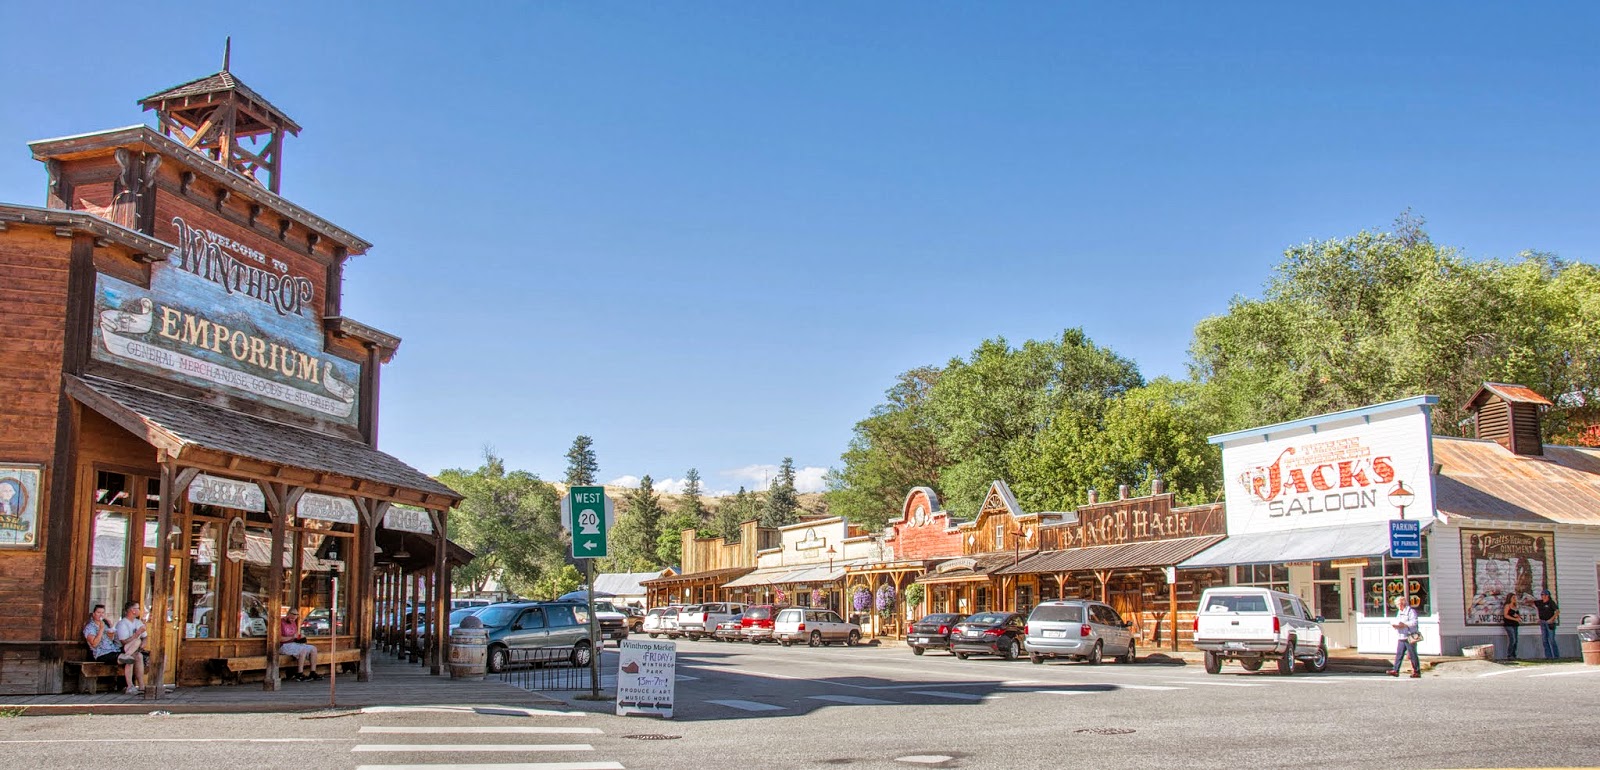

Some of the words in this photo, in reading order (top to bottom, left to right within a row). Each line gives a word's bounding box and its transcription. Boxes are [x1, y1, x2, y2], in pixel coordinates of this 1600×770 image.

[206, 229, 265, 264] WELCOME
[272, 258, 289, 274] TO
[172, 217, 314, 318] WINTHROP
[159, 305, 320, 385] EMPORIUM
[126, 341, 174, 367] GENERAL
[252, 379, 282, 397] GOODS
[1253, 447, 1395, 501] JACK'S
[197, 477, 247, 507] MILK
[574, 492, 601, 504] WEST
[1269, 489, 1377, 518] SALOON
[581, 513, 596, 525] 20
[1063, 509, 1129, 546] DANCE
[1392, 522, 1418, 532] PARKING
[1500, 544, 1534, 554] OINTMENT
[1372, 580, 1421, 594] GOOD
[1373, 594, 1421, 609] FOD
[623, 642, 652, 652] Winthrop
[653, 644, 675, 652] Market
